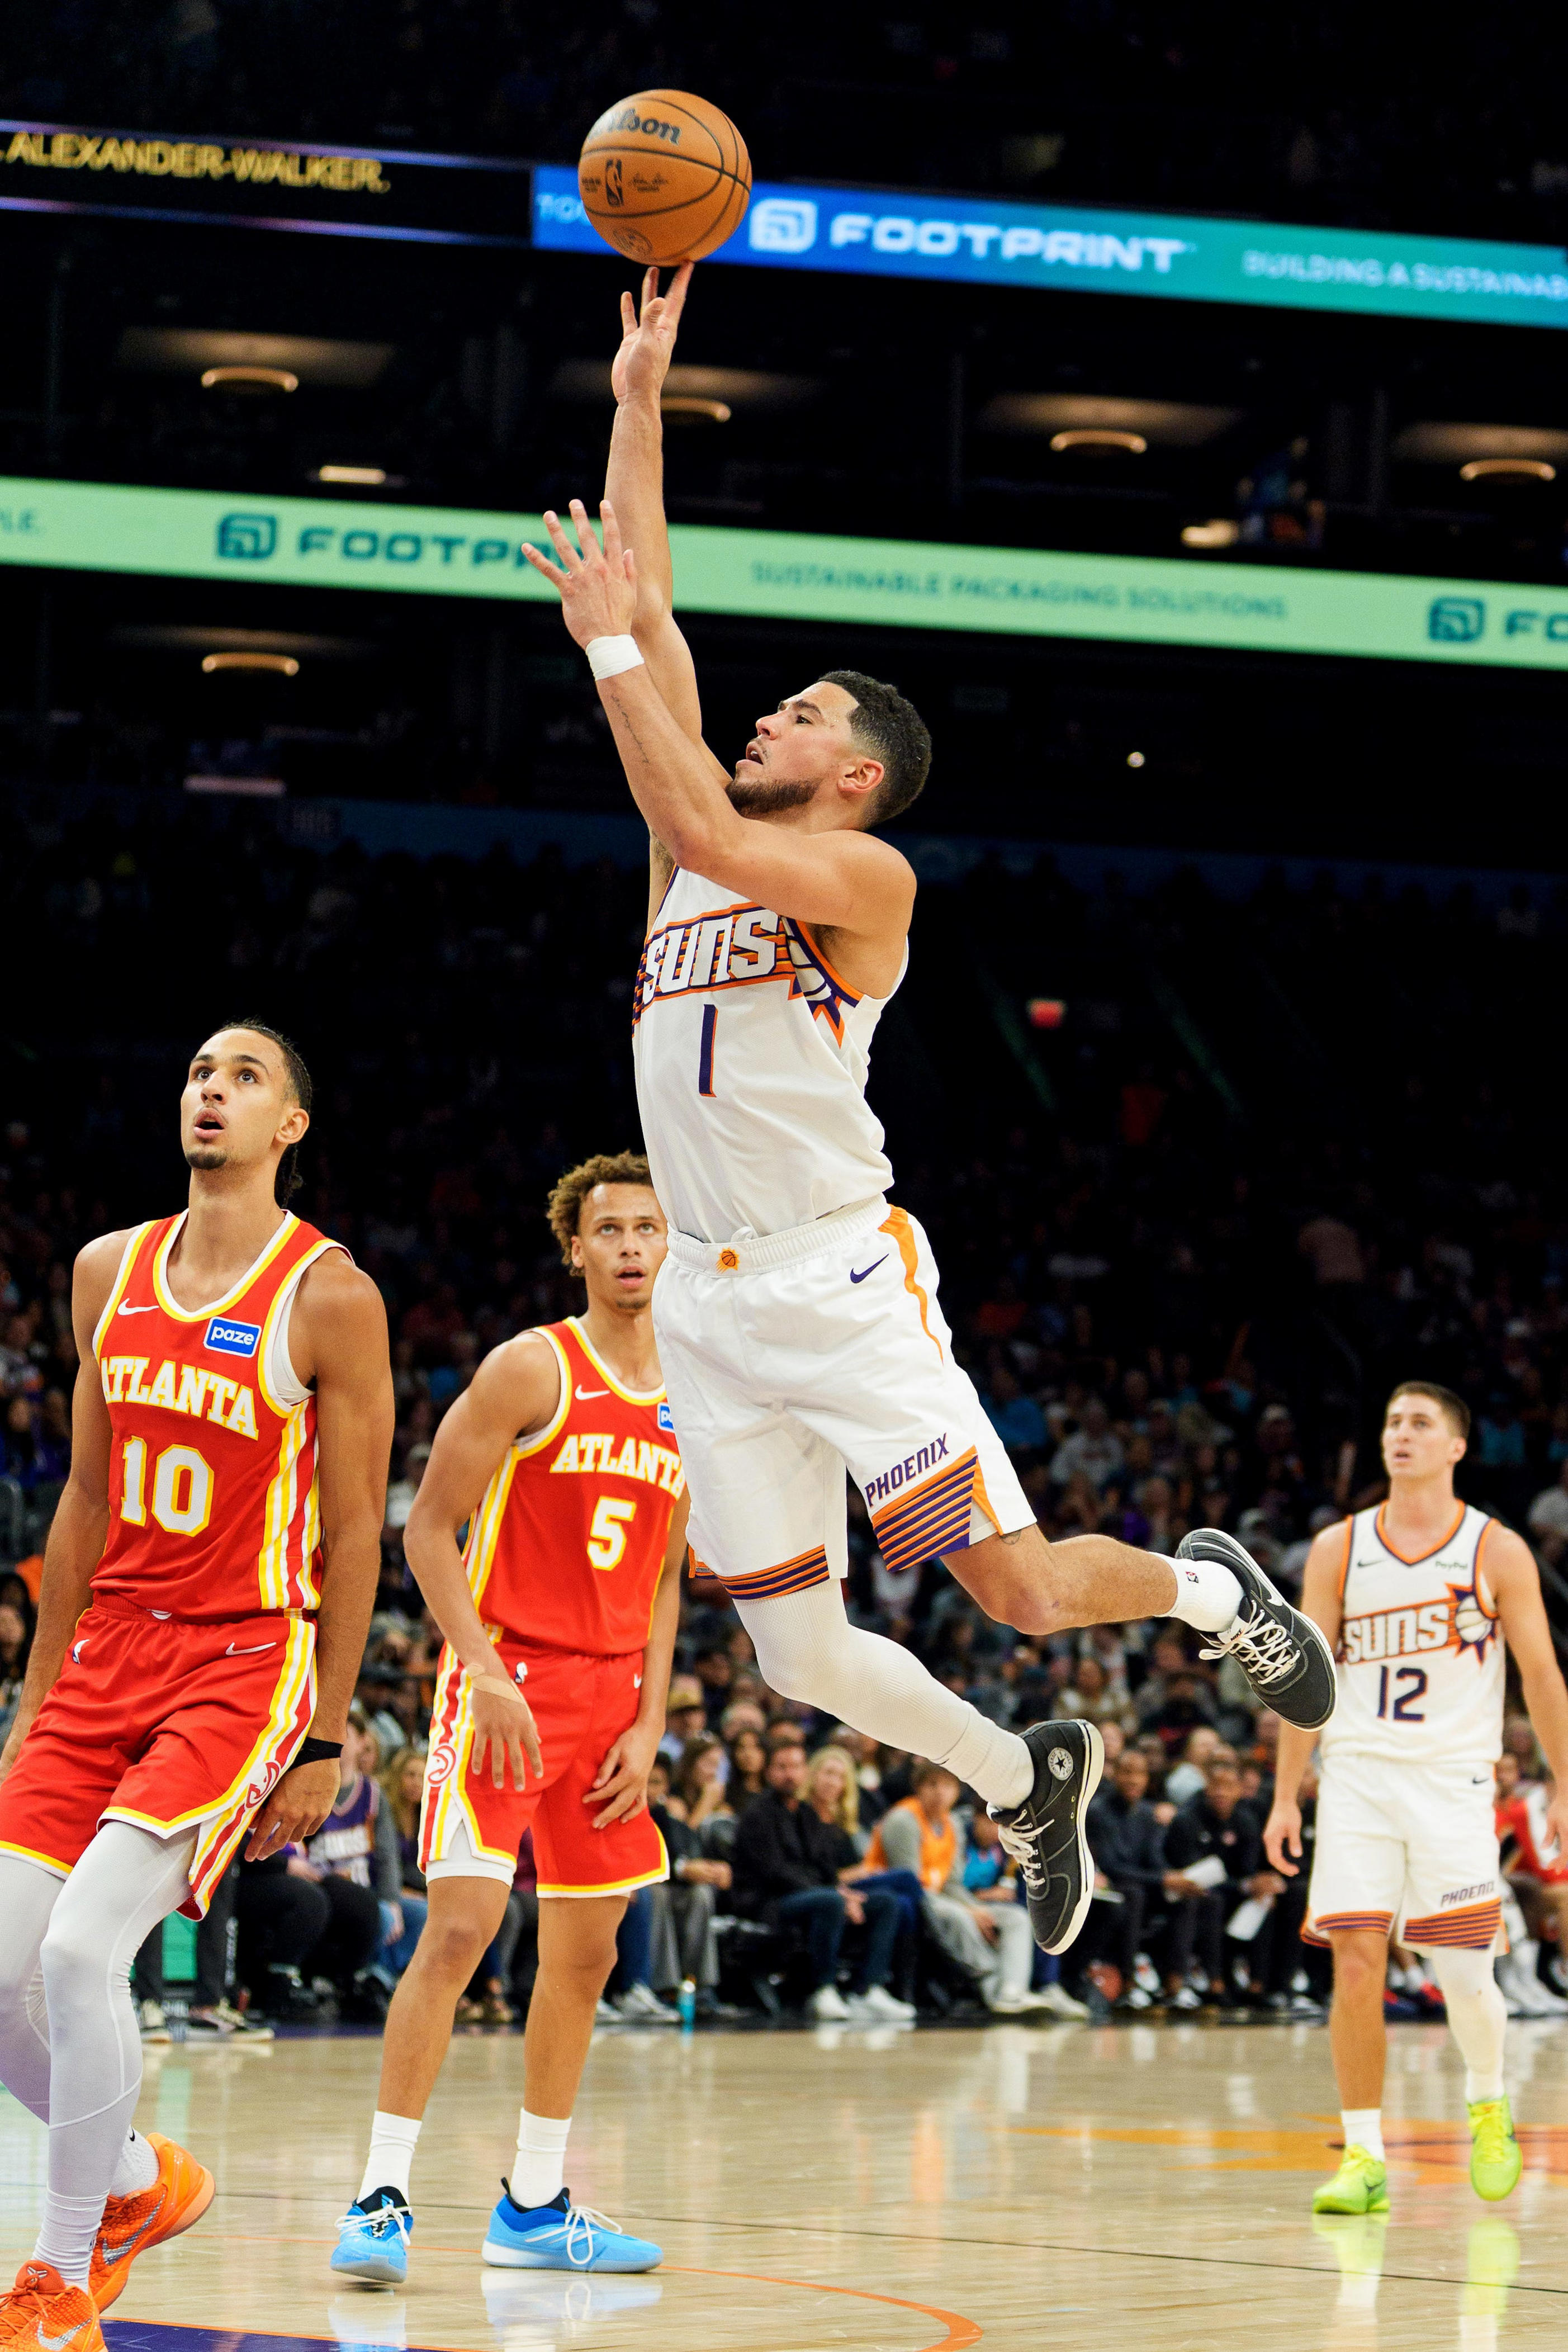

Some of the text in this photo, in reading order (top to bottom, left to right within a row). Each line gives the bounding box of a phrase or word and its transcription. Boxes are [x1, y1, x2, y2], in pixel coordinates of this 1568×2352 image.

[6, 131, 390, 193] ALEXANDER-WALKER.
[830, 214, 1186, 273] FOOTPRINT
[1242, 250, 1384, 287] BUILDING
[1386, 261, 1410, 287] A
[752, 561, 1287, 619] SUSTAINABLE PACKAGING SOLUTIONS
[642, 908, 779, 1005] SUNS
[699, 1004, 718, 1098] 1
[210, 1325, 255, 1346] paze
[120, 1436, 214, 1537] 10
[864, 1432, 950, 1508] PHOENIX
[586, 1496, 637, 1571] 5
[1435, 1560, 1468, 1572] PayPal
[1345, 1603, 1450, 1664] SUNS
[1377, 1665, 1428, 1722] 12
